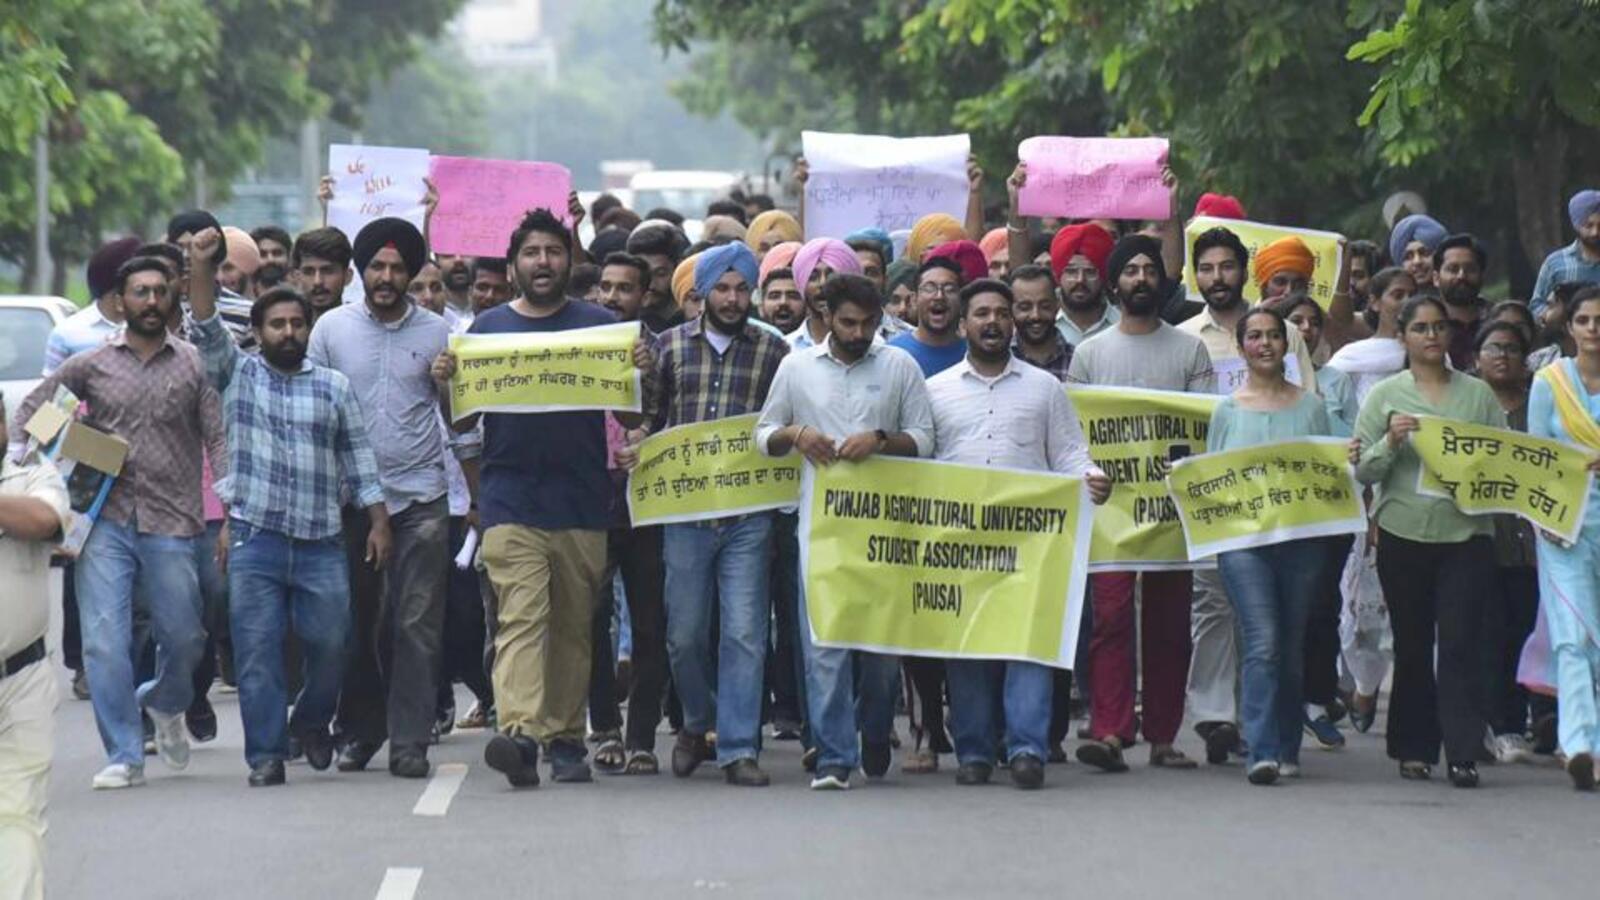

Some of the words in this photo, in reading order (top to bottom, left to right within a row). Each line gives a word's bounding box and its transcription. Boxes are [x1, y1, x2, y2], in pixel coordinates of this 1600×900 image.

[1089, 414, 1189, 446] AGRICULTURAL
[1469, 471, 1519, 500] ਮੰਗਦੇ
[824, 489, 881, 520] PUNJAB
[884, 494, 976, 530] AGRICULTURAL
[981, 507, 1067, 534] UNIVERSITY
[868, 535, 920, 566] STUDENT
[923, 541, 1017, 573] ASSOCIATION
[912, 582, 963, 617] (PAUSA)
